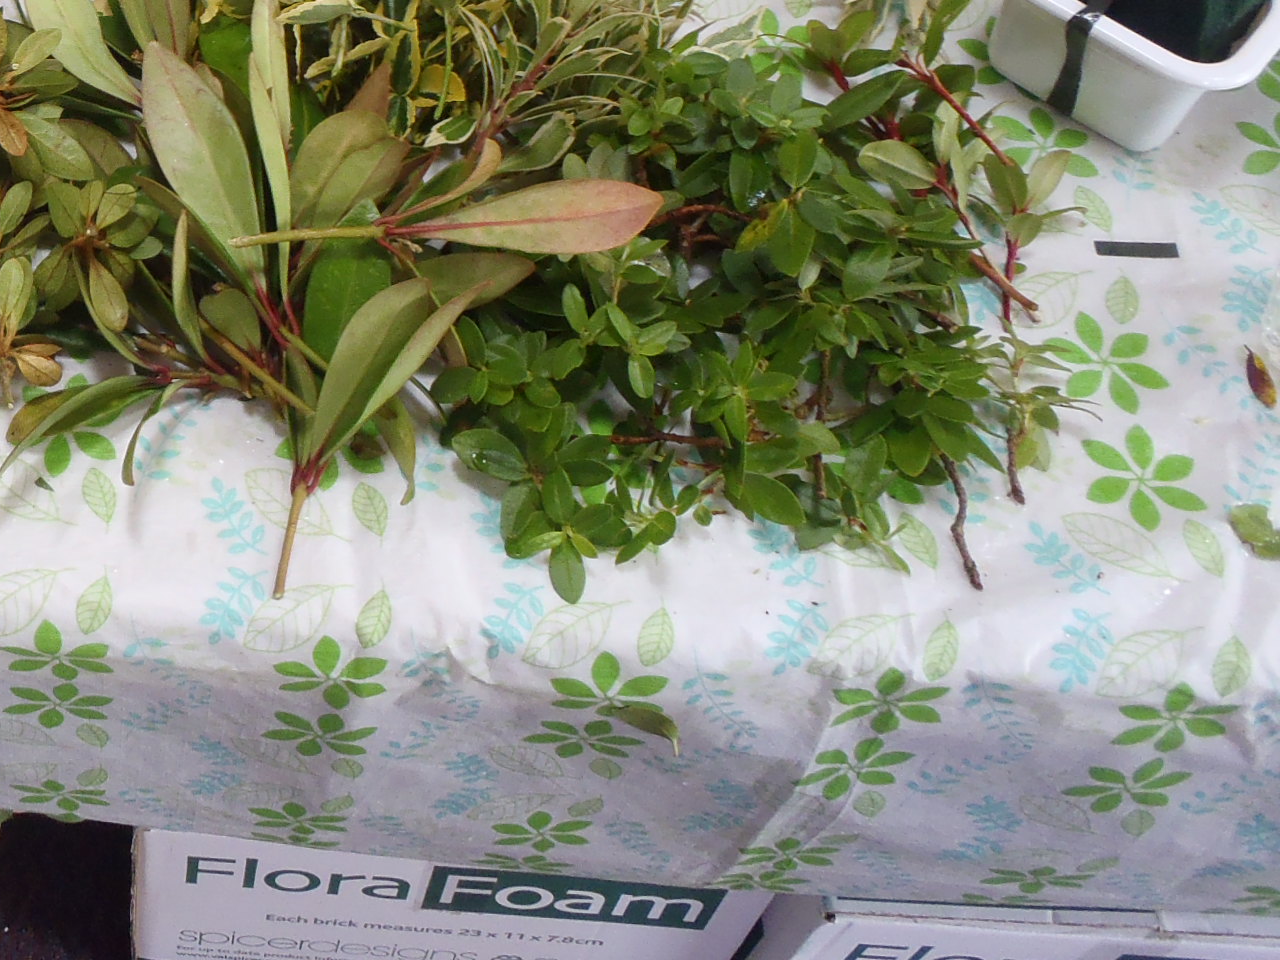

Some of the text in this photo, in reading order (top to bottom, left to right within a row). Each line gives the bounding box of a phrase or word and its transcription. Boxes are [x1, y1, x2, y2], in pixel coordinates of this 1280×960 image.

[185, 855, 705, 923] Flora Foam
[178, 929, 479, 960] spicerdesigns
[265, 913, 308, 925] Each
[313, 917, 357, 928] brick
[363, 922, 453, 935] measures
[457, 928, 482, 937] 23
[504, 931, 524, 940] 11
[547, 934, 604, 946] 7.8cm
